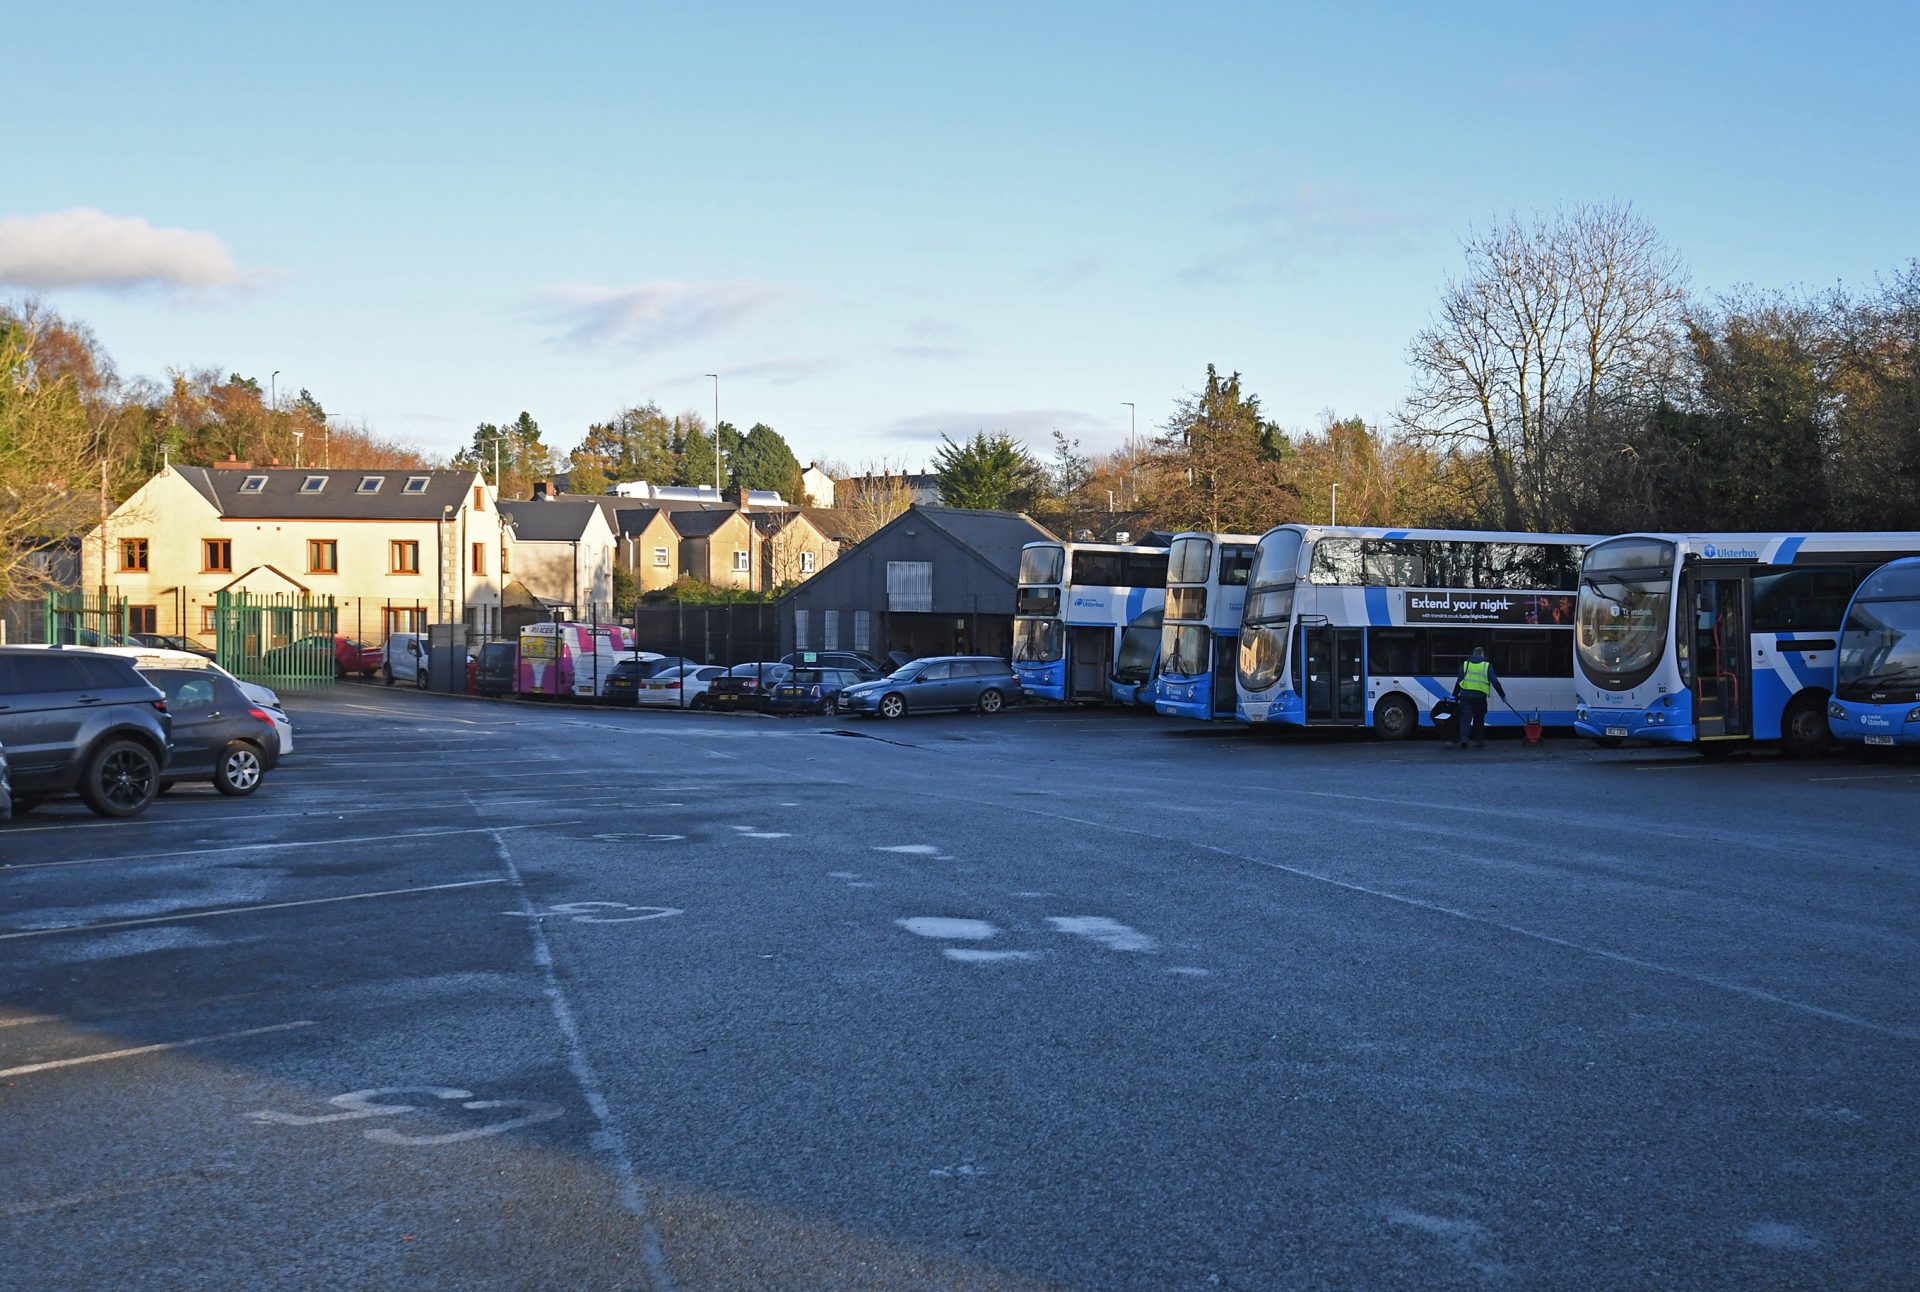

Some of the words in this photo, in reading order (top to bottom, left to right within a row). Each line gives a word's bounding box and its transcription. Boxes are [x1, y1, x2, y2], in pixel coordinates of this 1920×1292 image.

[1717, 548, 1757, 557] Ulsterbus
[1411, 593, 1450, 609] Extend
[1453, 600, 1478, 612] your
[1480, 595, 1511, 612] night
